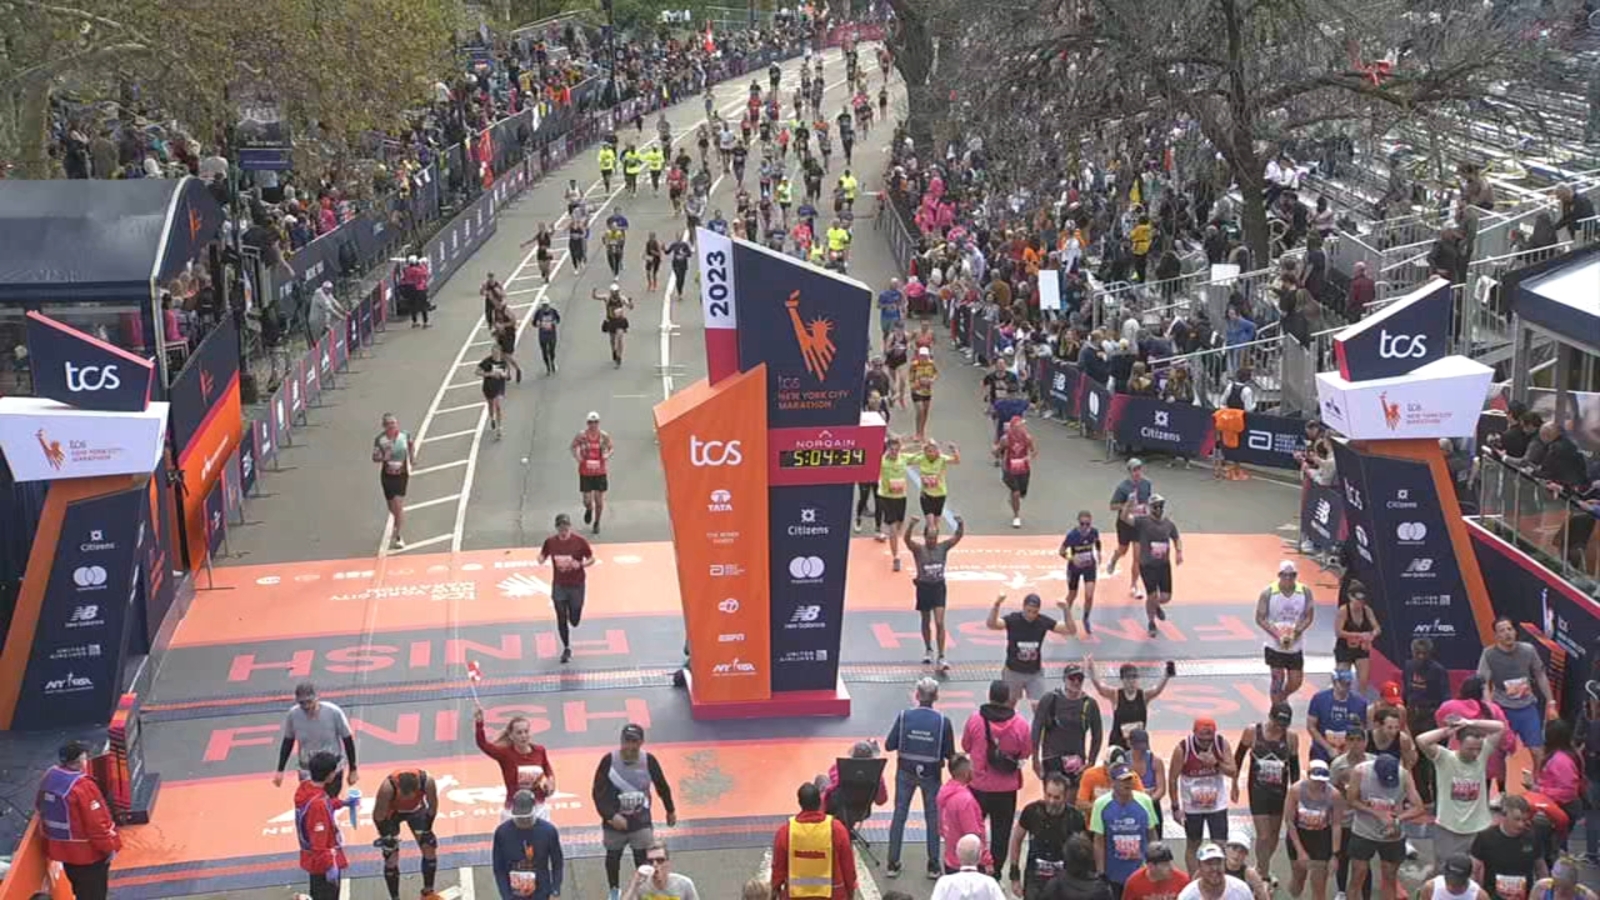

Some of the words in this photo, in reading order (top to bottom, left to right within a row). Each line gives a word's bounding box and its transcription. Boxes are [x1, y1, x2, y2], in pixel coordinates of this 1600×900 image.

[706, 250, 730, 317] 2023
[1379, 329, 1427, 359] tcs
[64, 361, 120, 392] tcs
[778, 401, 832, 410] MARATHON
[802, 390, 827, 400] YORK
[828, 390, 849, 399] CITY
[1140, 427, 1181, 442] Citizens
[690, 435, 742, 466] tcs
[788, 525, 829, 536] Citizens
[228, 629, 630, 682] FINISH
[202, 698, 651, 762] FNISH
